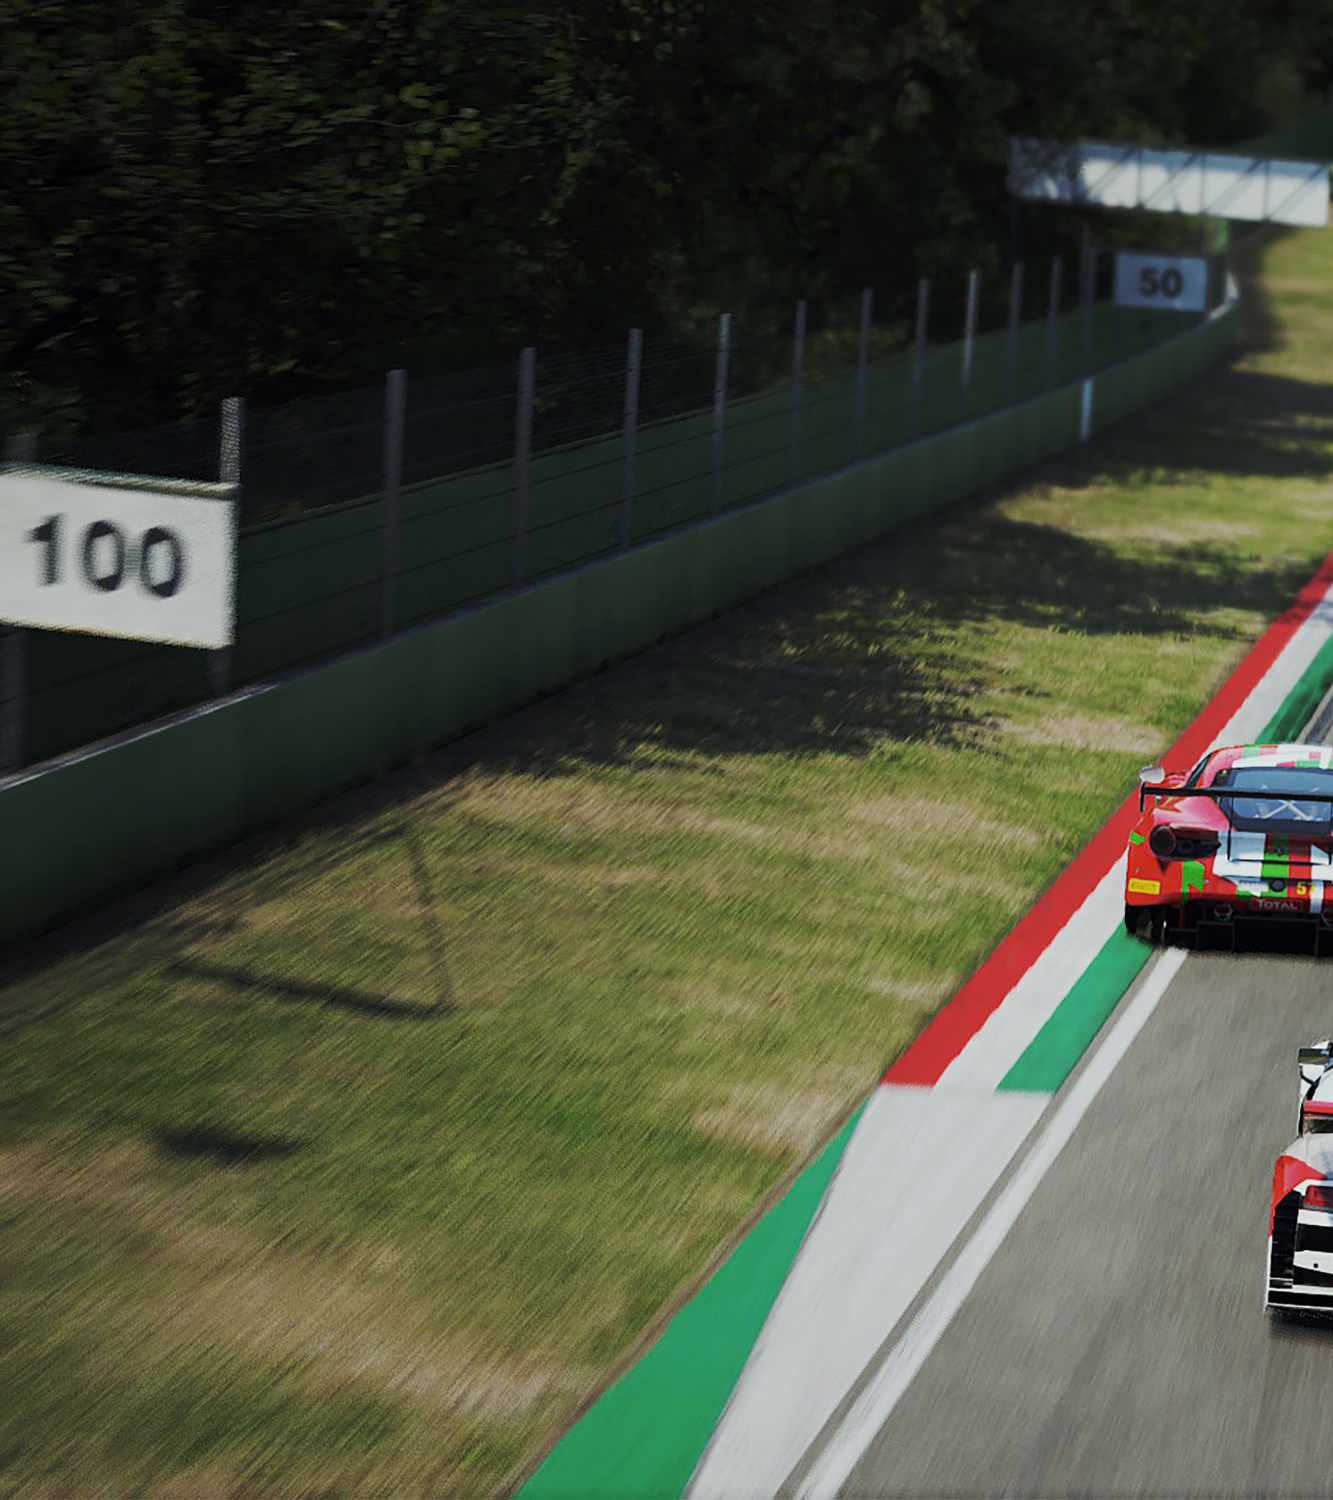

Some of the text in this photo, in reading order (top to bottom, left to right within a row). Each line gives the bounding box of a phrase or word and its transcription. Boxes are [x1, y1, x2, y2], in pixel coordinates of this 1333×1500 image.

[1136, 266, 1185, 298] 50
[25, 513, 188, 600] 100
[1256, 899, 1299, 910] TOTAL
